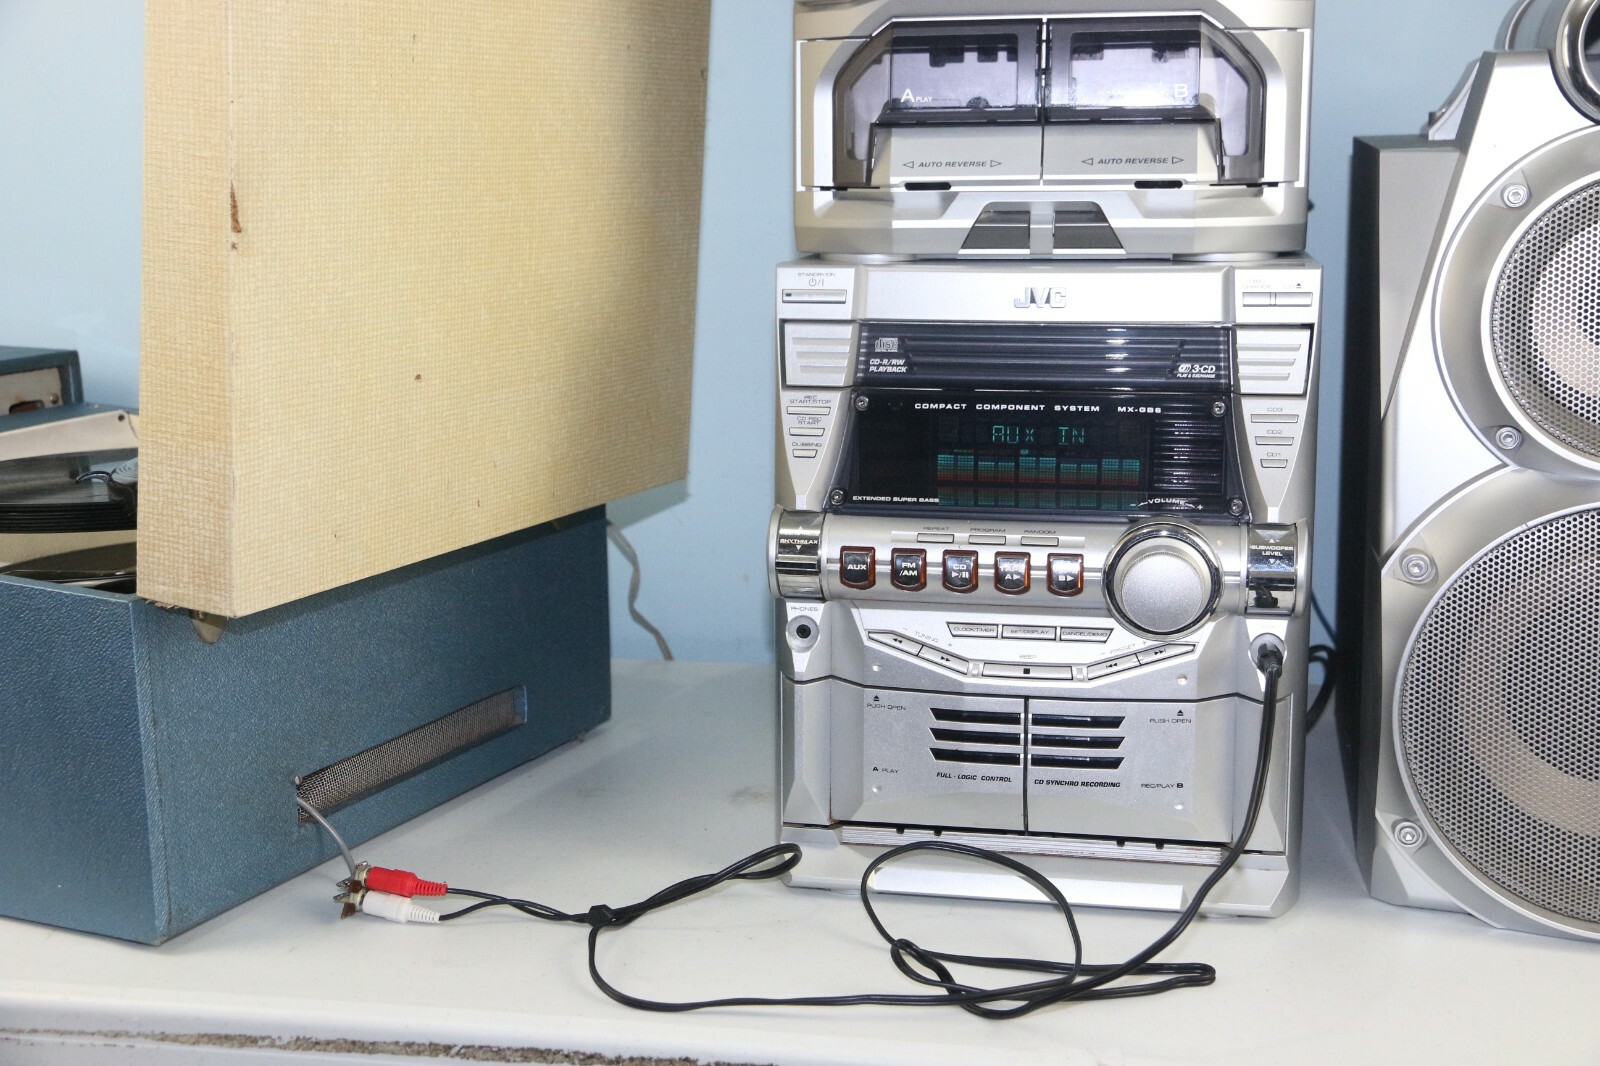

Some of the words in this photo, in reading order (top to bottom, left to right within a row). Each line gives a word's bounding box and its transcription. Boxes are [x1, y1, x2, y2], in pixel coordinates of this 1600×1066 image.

[1174, 83, 1189, 98] B
[900, 88, 915, 103] A
[944, 160, 987, 168] REVERSE
[1013, 286, 1067, 309] JVC
[869, 358, 906, 366] CD-R/RW
[1191, 364, 1216, 374] 3-CD
[992, 425, 1035, 444] AUX
[1057, 426, 1086, 445] IN
[1147, 497, 1186, 506] VOLUME
[847, 563, 867, 571] AUX
[901, 561, 916, 569] FM
[914, 630, 939, 644] TUNING
[980, 775, 1012, 783] CONTROL
[1045, 779, 1080, 787] SYNCHRO
